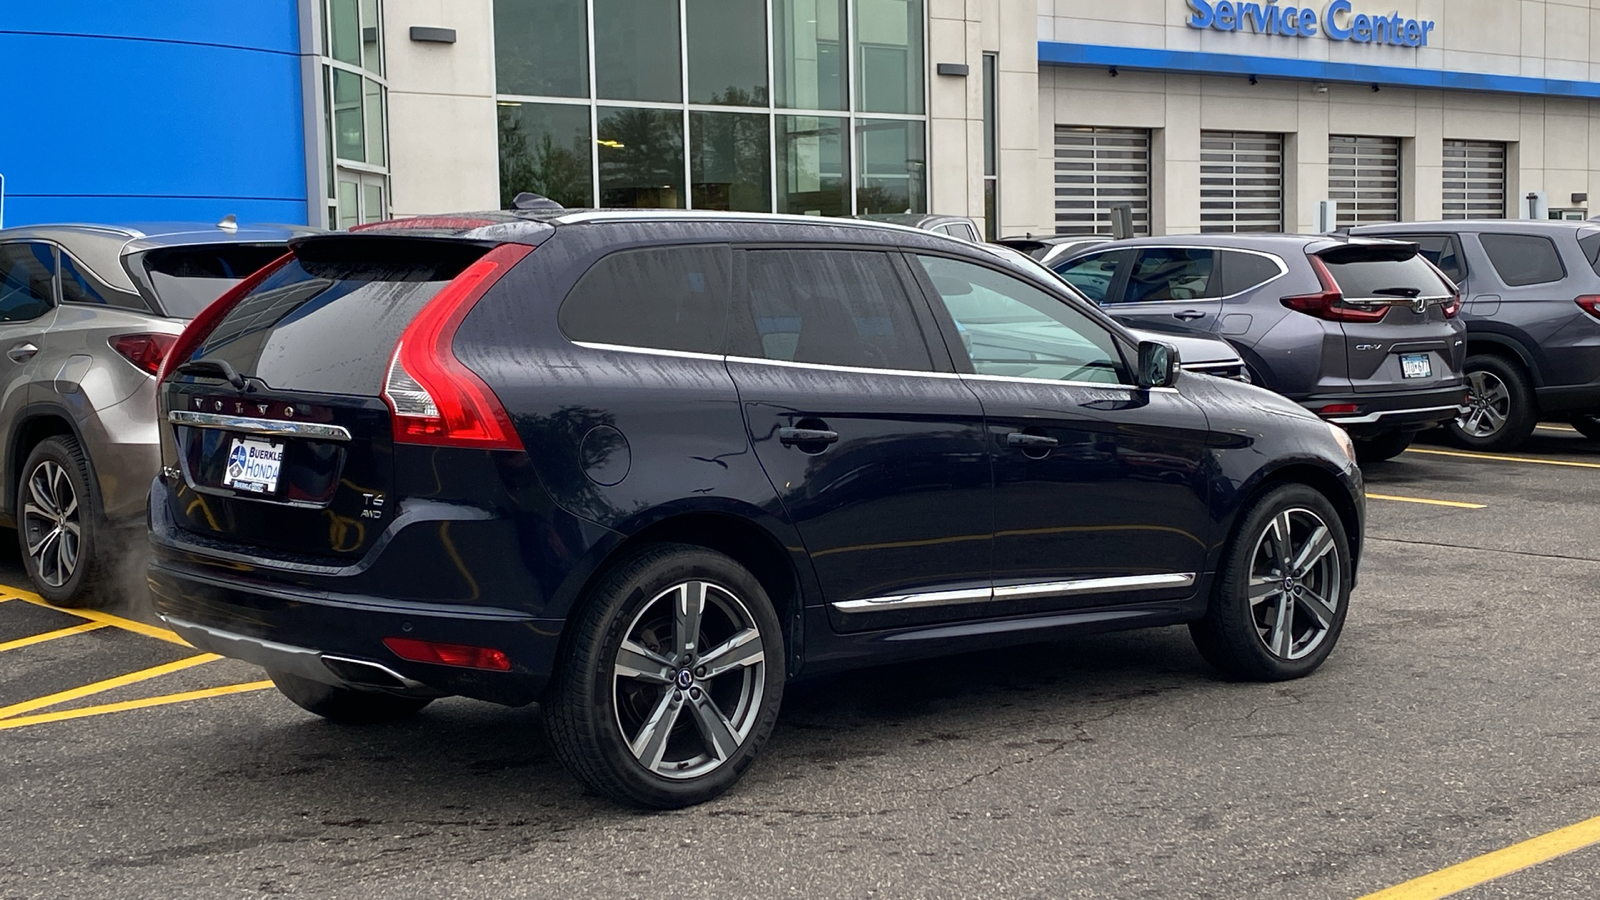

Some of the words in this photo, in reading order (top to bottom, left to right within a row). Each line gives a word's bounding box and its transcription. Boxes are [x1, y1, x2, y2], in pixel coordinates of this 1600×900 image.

[1186, 0, 1317, 37] Service
[1321, 0, 1434, 47] Center
[193, 397, 294, 418] VOLVO
[249, 446, 283, 462] BUERKLE
[245, 458, 279, 480] HONDA
[362, 493, 384, 506] T6
[360, 509, 382, 519] AWD
